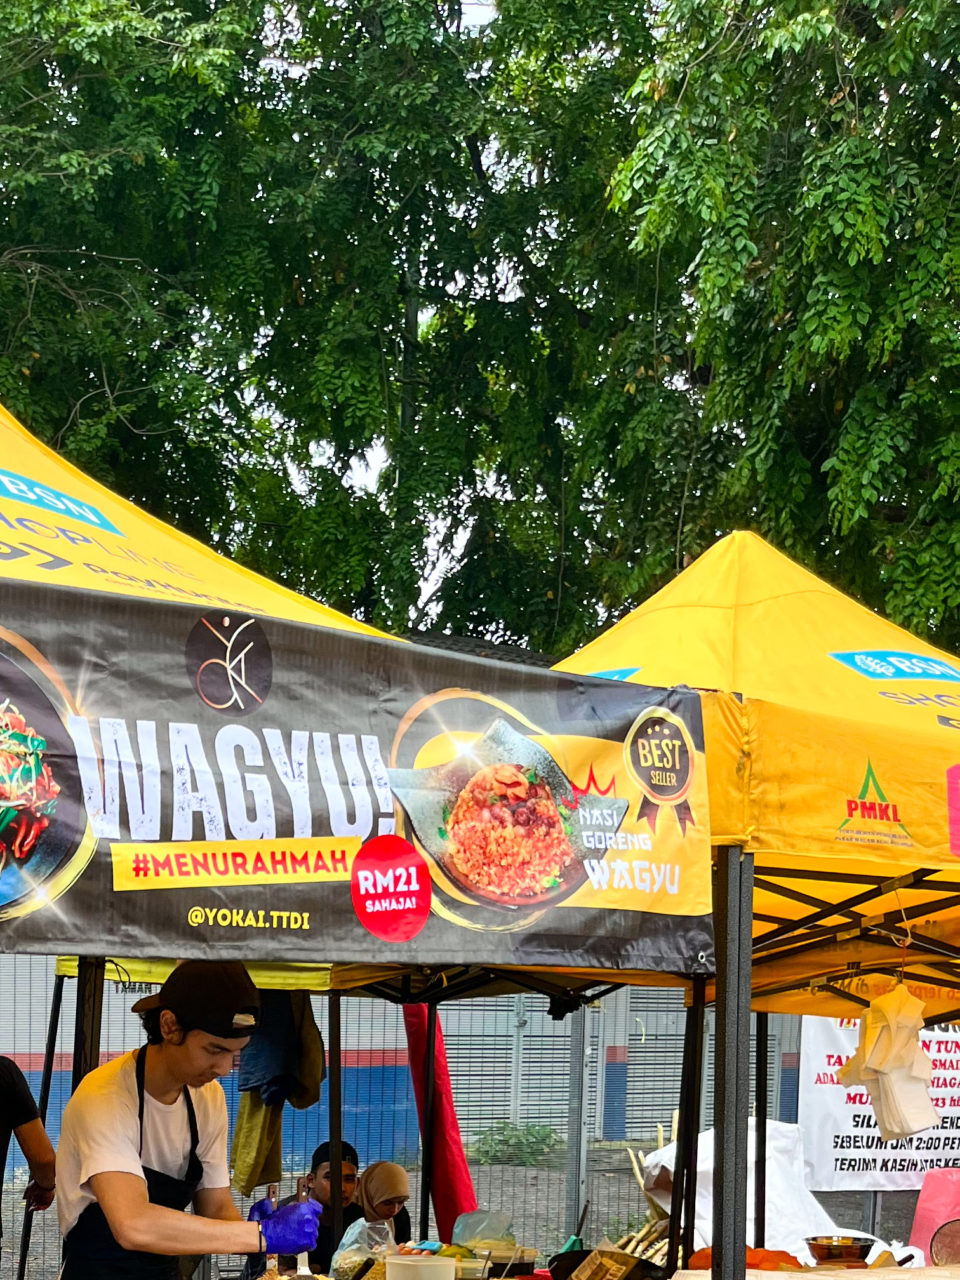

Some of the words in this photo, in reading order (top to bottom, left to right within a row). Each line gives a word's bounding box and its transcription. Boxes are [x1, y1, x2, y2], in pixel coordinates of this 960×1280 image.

[637, 738, 681, 770] BEST
[67, 715, 396, 841] WAGYU!
[651, 770, 677, 787] SELLER
[579, 808, 619, 827] NASI
[846, 799, 901, 823] PMKL
[582, 831, 652, 851] GORENG
[132, 849, 349, 879] #MENURAHMAH
[358, 866, 420, 895] RM21
[583, 859, 680, 895] WAGYU
[365, 897, 416, 913] SAHAJA!
[187, 907, 310, 930] @YOKAI.TTDI
[915, 1136, 940, 1151] 2:00
[834, 1158, 878, 1173] TERIMA
[879, 1158, 918, 1172] KASIH
